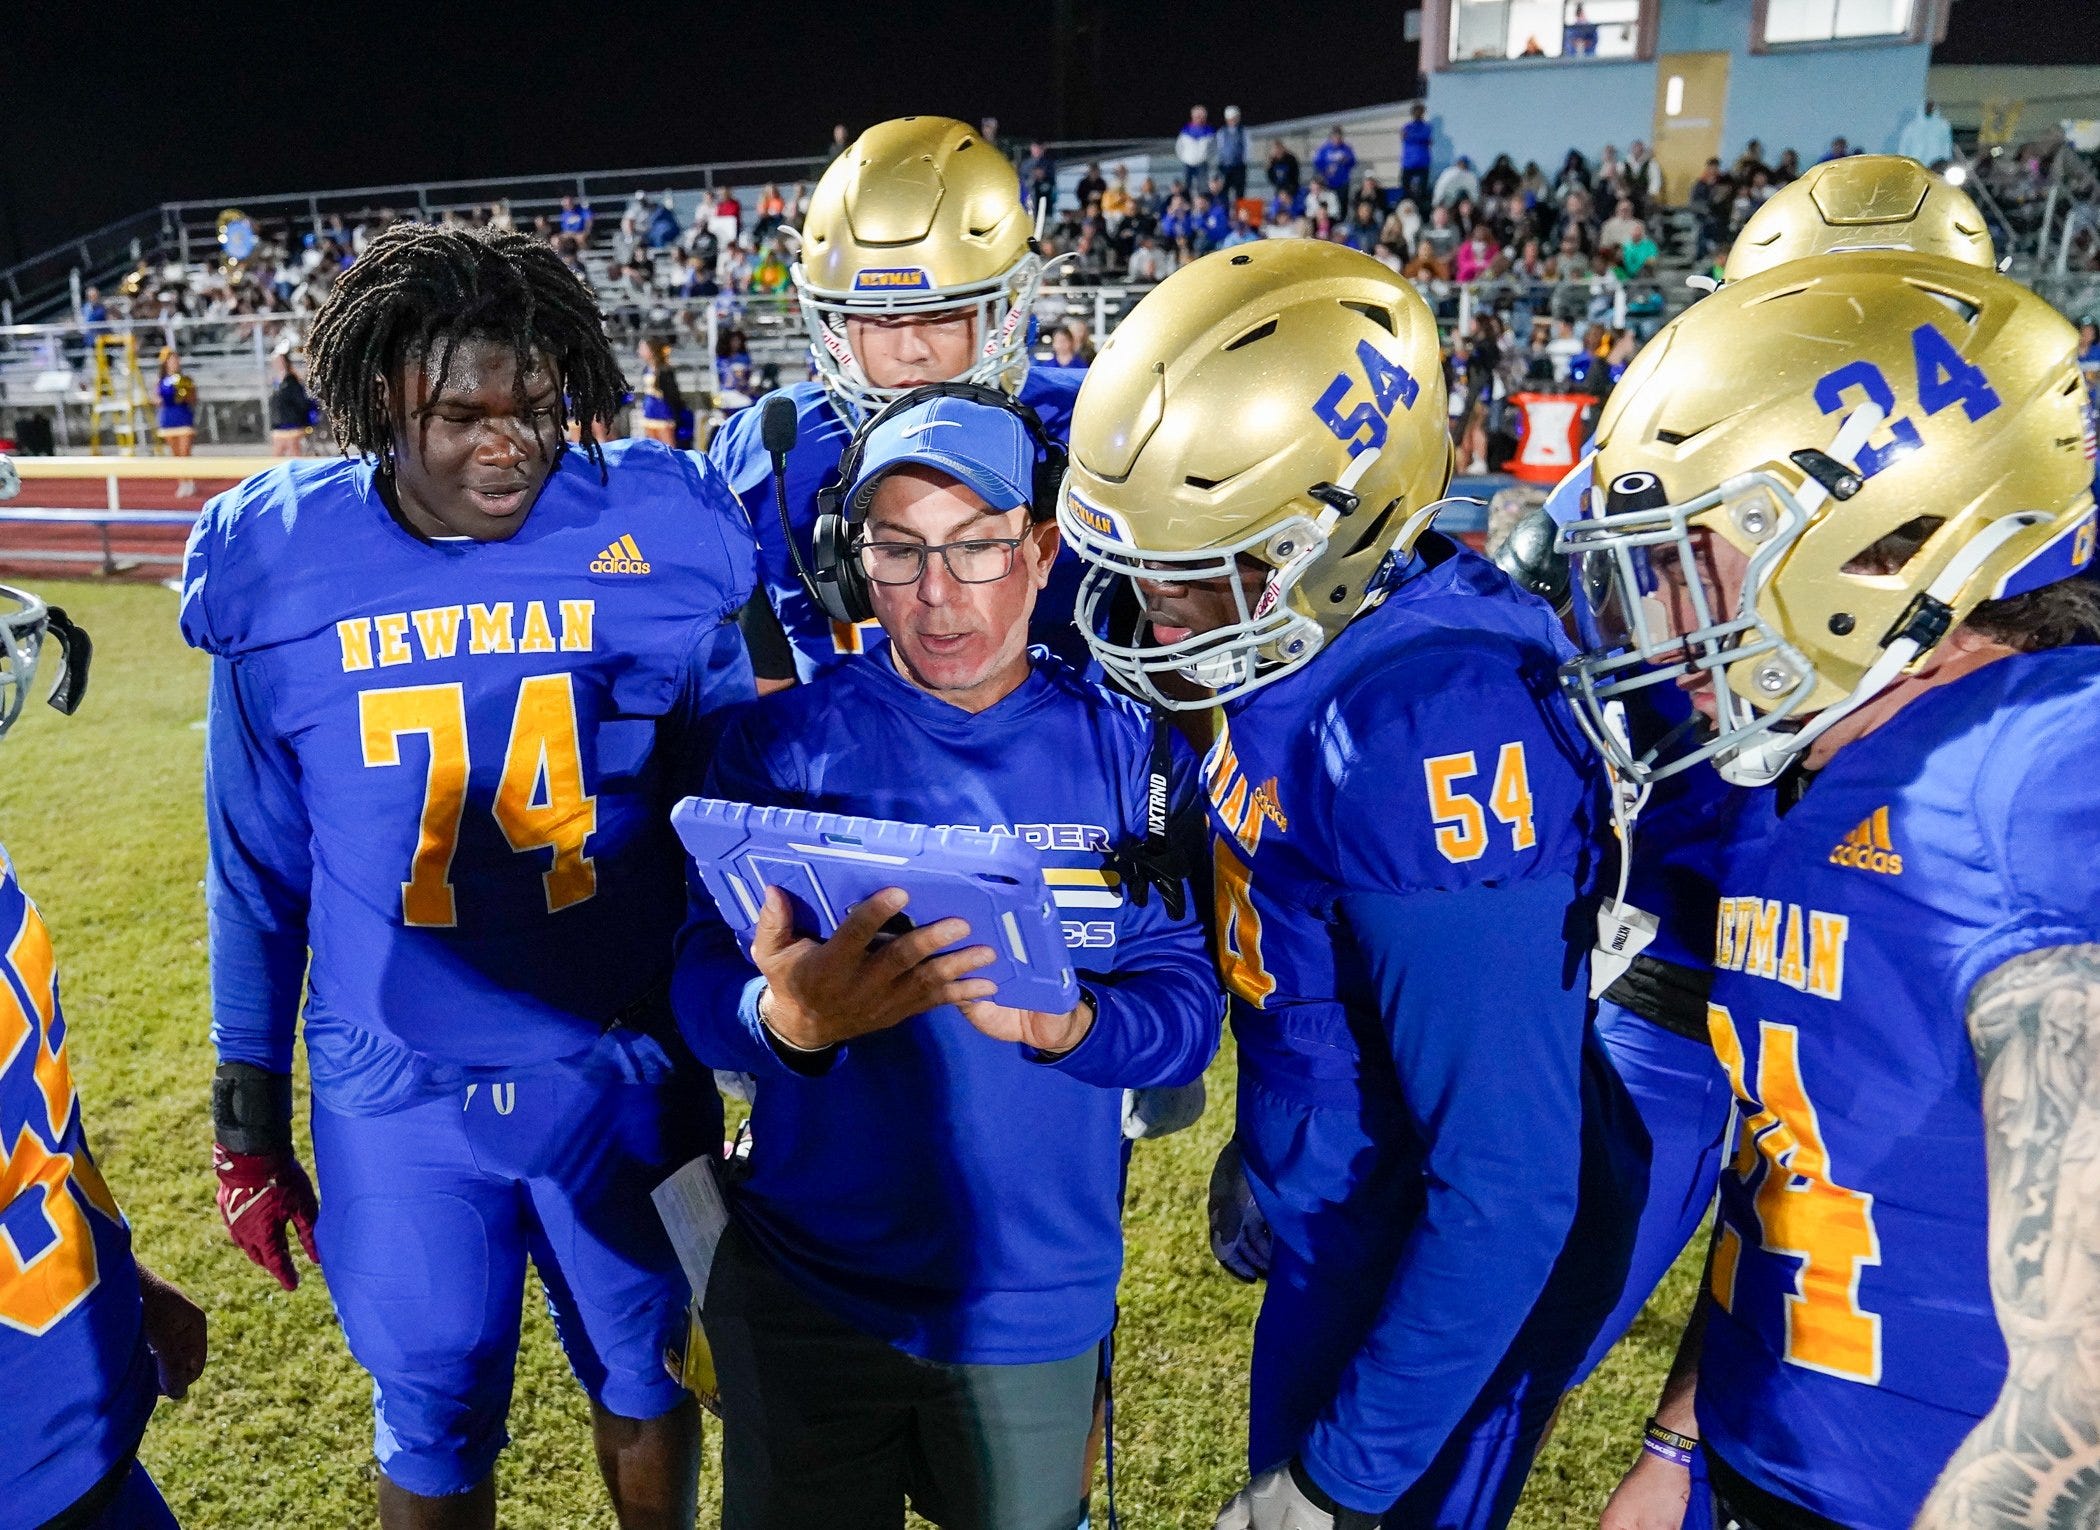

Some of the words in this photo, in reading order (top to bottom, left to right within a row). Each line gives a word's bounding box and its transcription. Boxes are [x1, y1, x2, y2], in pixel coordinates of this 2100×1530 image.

[1312, 339, 1420, 459] 54
[1814, 324, 2001, 480] 24
[589, 557, 651, 575] adidas
[337, 600, 594, 673] NEWMAN
[358, 672, 597, 928] 74
[1149, 773, 1167, 837] NXTRND
[1208, 740, 1265, 858] MAN
[1423, 741, 1537, 864] 54
[1611, 924, 1632, 951] NXTRND
[1714, 896, 1850, 1002] EWMAN
